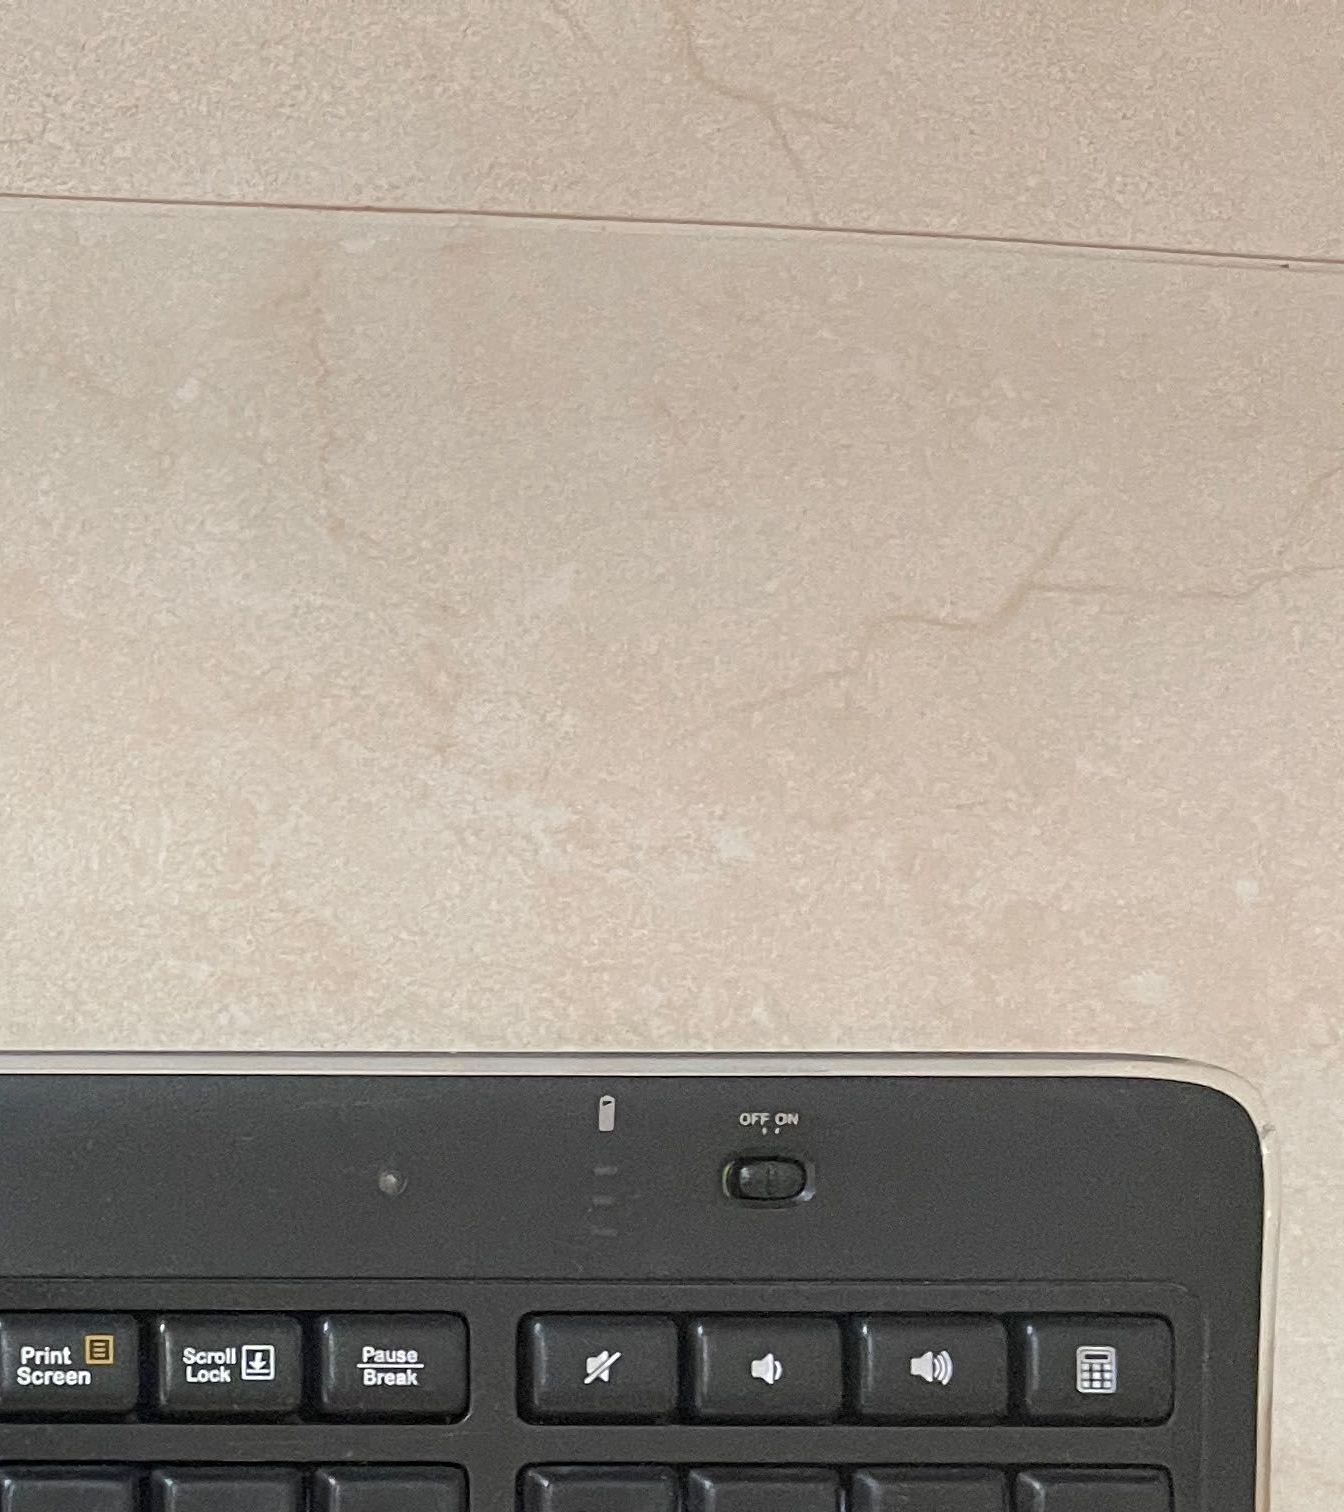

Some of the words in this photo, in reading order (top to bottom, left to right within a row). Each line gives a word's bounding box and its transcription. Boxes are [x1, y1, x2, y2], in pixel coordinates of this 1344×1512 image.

[739, 1112, 770, 1126] OFF
[774, 1112, 799, 1126] ON
[19, 1346, 73, 1365] Print
[182, 1347, 237, 1365] Scroll
[362, 1346, 418, 1363] Pause
[16, 1367, 93, 1387] Screen
[185, 1365, 231, 1383] Lock
[363, 1368, 418, 1386] Break
